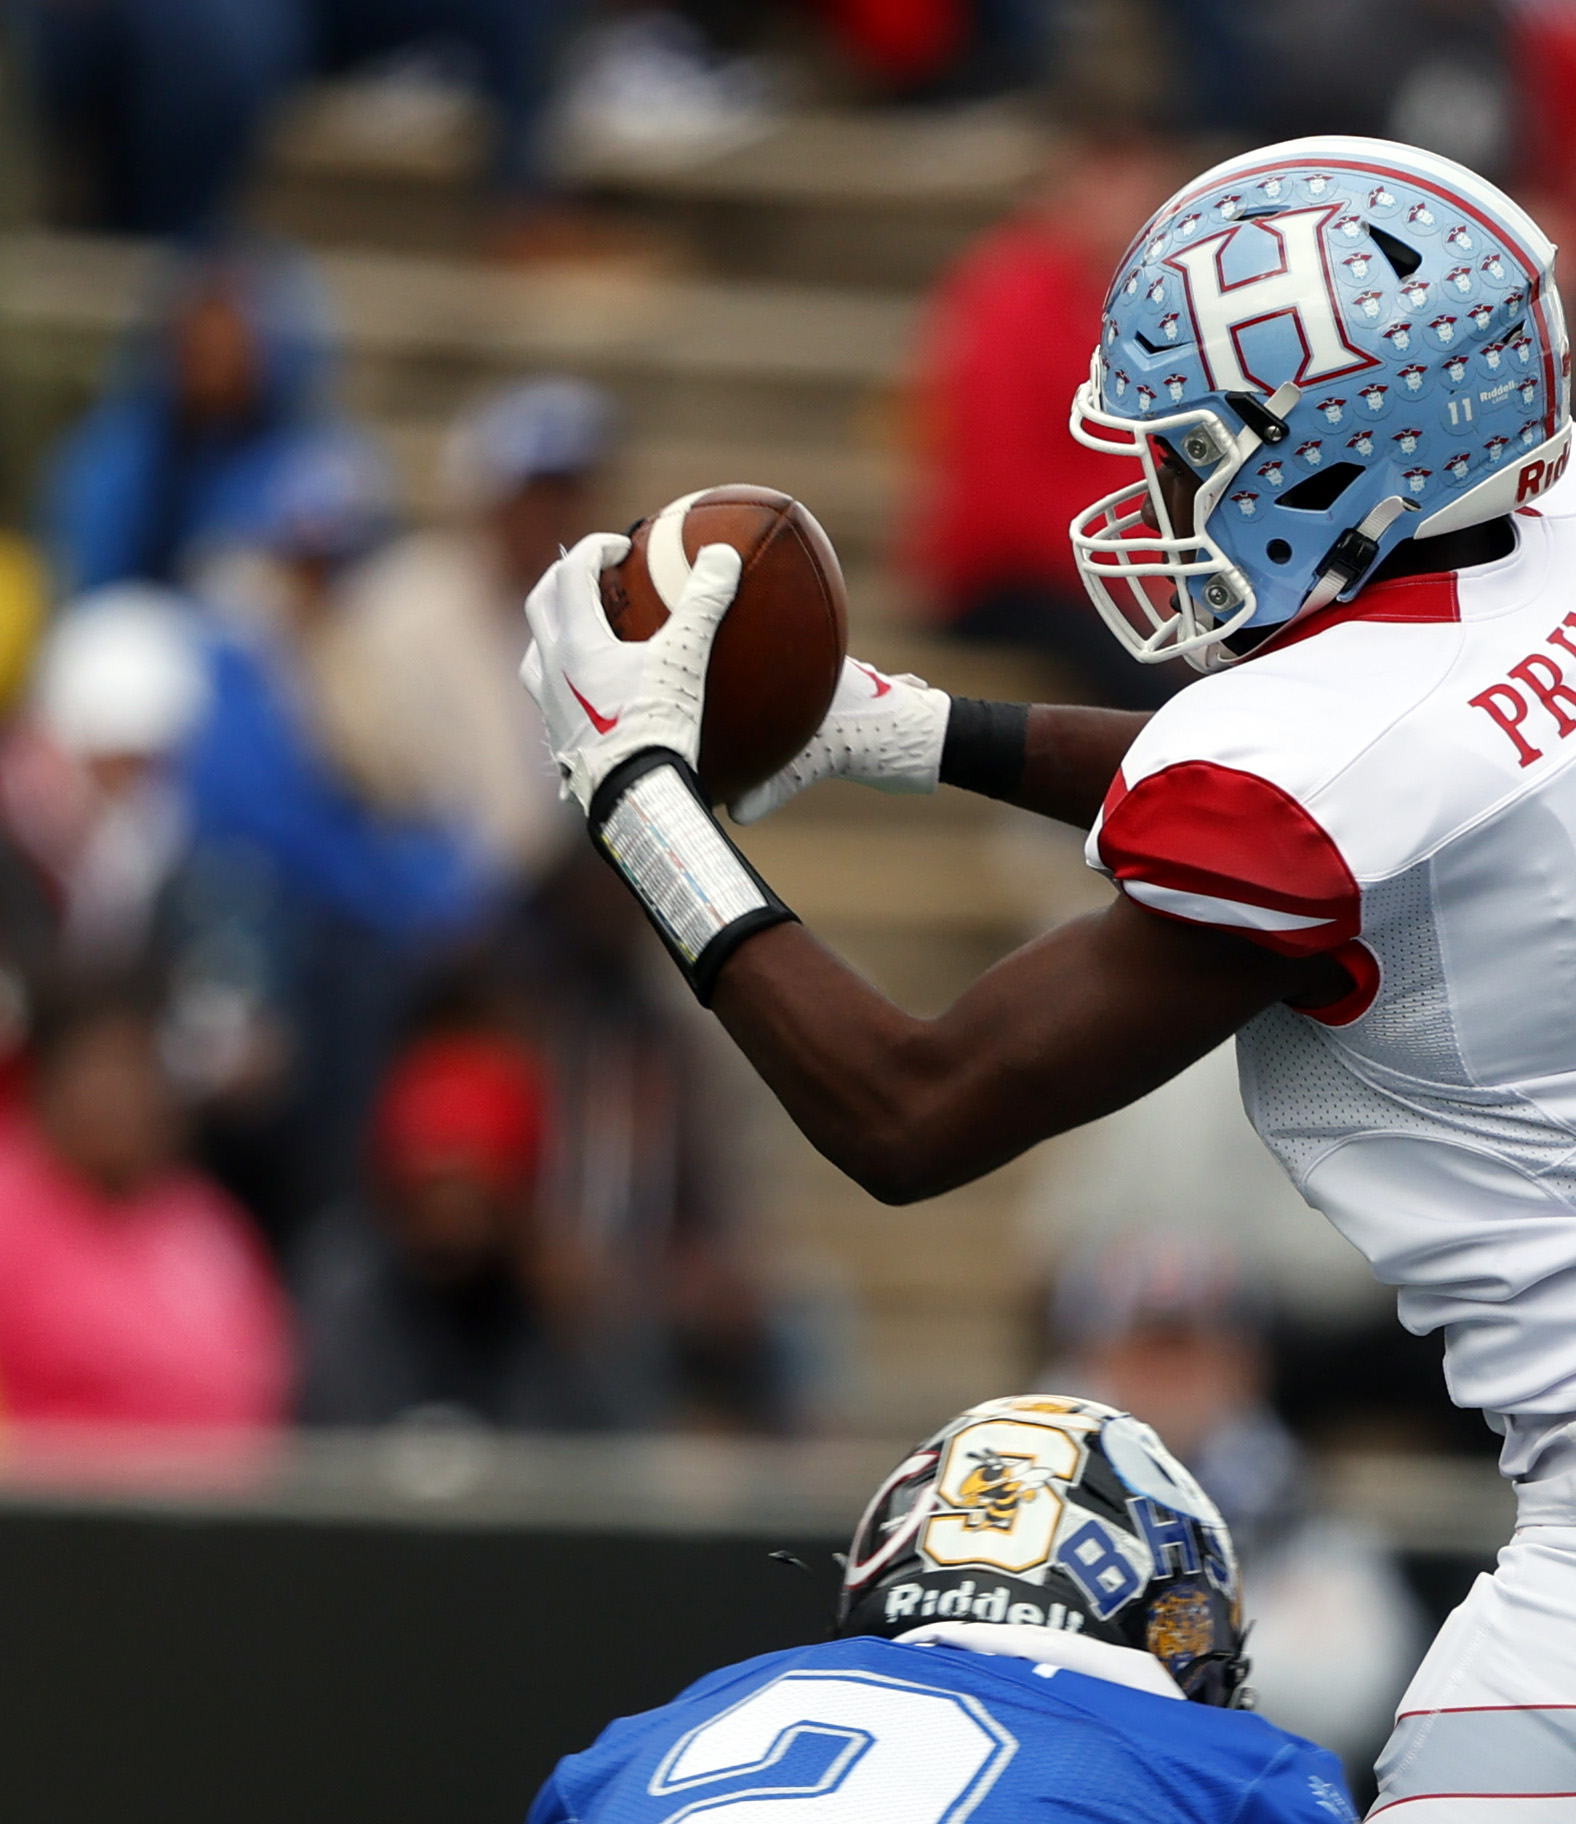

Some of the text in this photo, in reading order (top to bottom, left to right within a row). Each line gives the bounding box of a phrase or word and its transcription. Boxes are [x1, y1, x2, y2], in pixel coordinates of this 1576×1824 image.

[1162, 201, 1382, 396] H
[1479, 379, 1516, 403] Riddell
[1447, 397, 1473, 426] 11
